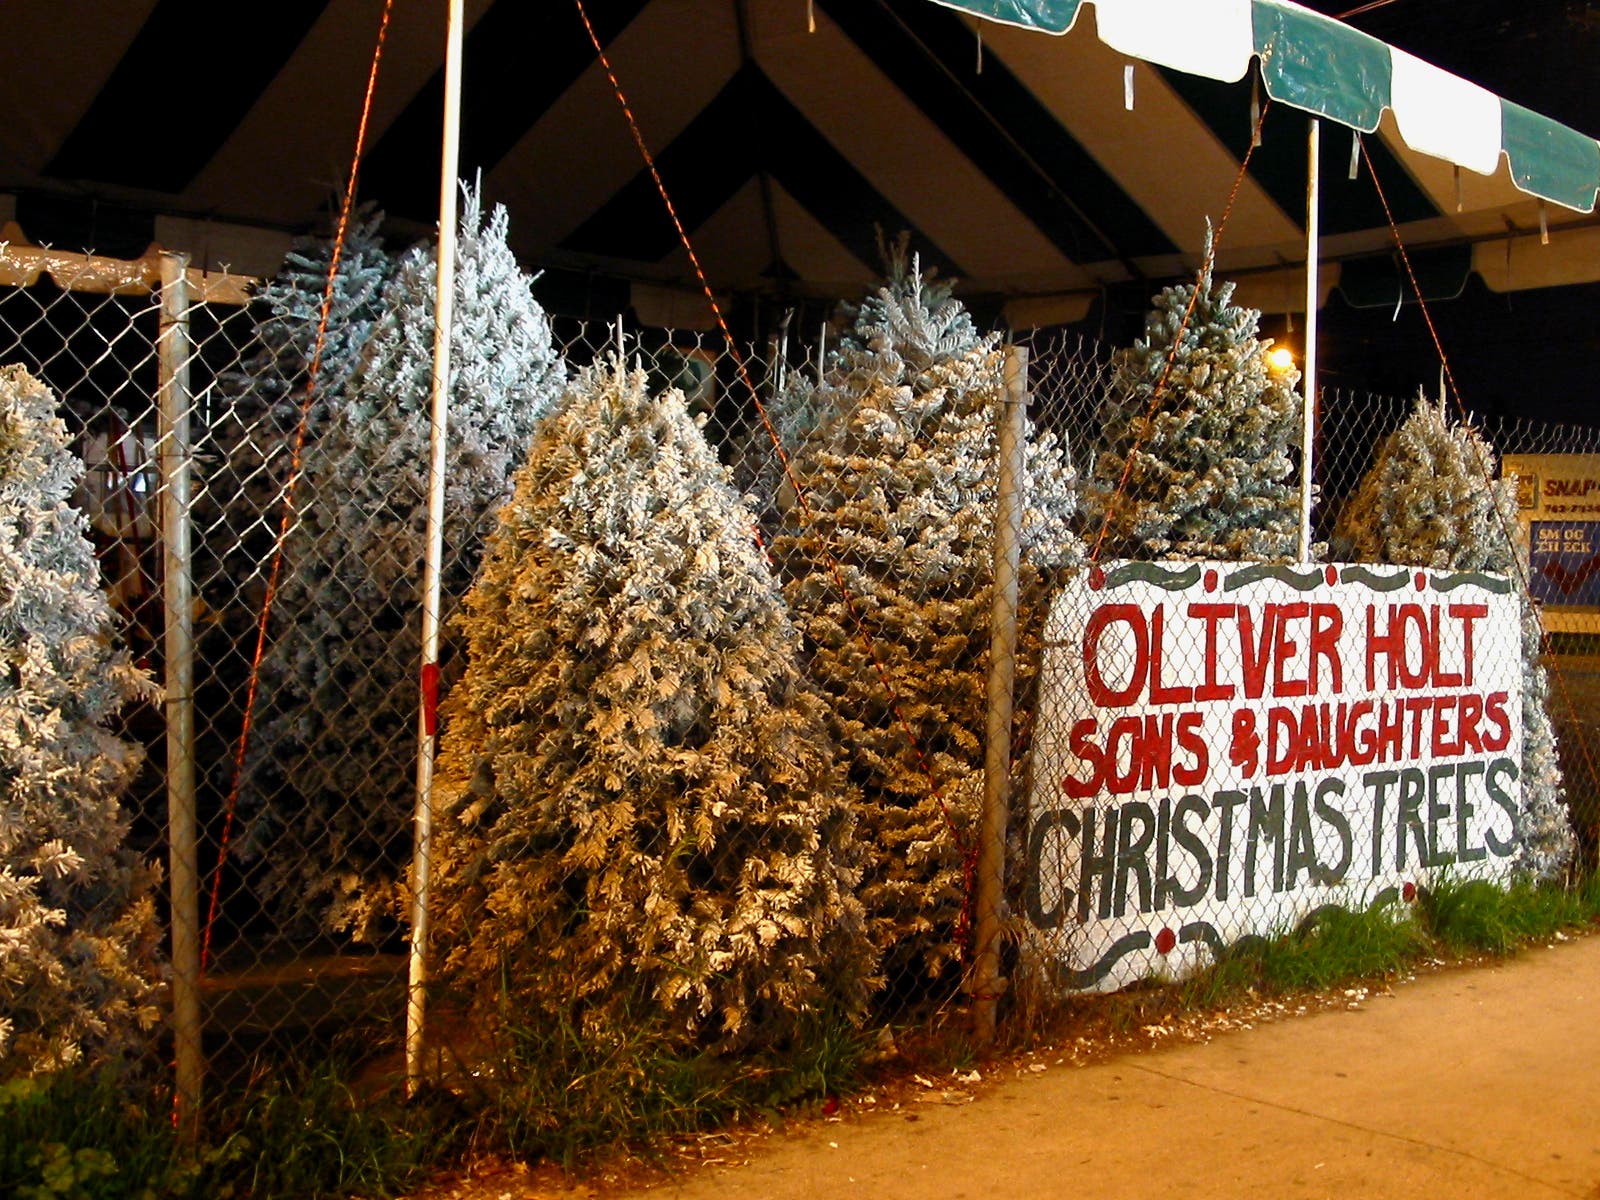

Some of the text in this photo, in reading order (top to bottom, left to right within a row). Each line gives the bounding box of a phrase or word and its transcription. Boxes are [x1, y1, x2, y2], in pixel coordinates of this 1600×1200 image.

[1084, 603, 1489, 706] OLIVER HOLT
[1062, 692, 1511, 799] SONS & DAUGHTERS
[1029, 758, 1520, 929] CHRISTMAS TREES
